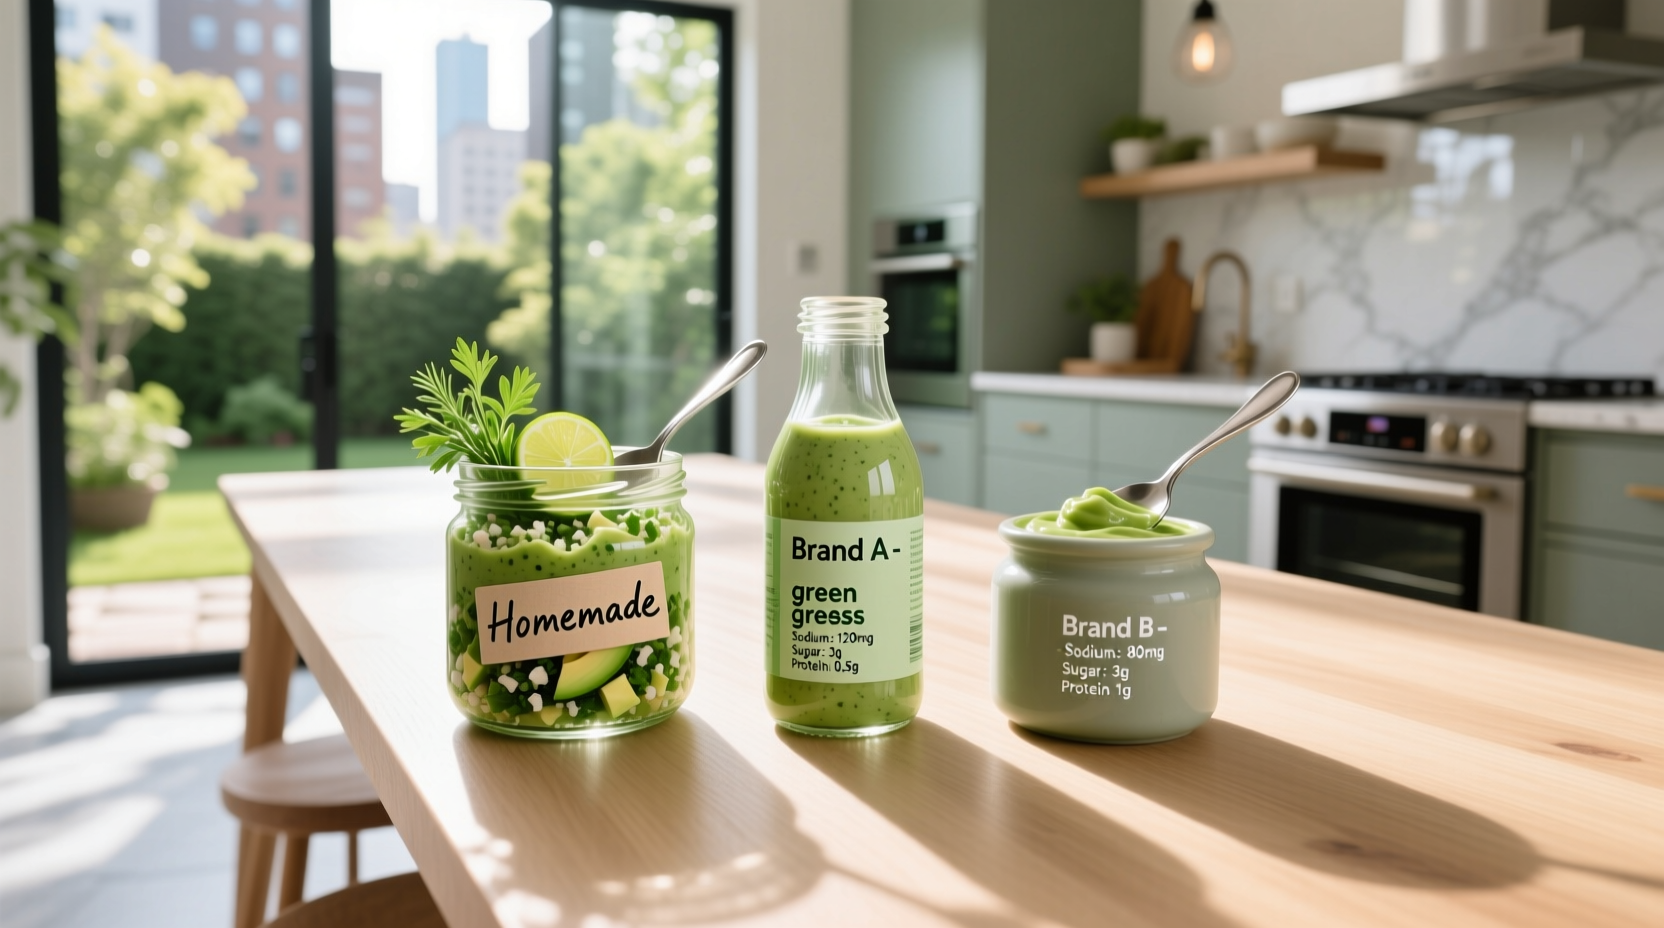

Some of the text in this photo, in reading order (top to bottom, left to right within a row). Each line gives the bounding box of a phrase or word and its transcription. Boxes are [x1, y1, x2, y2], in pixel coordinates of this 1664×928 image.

[791, 536, 864, 562] Brand
[791, 584, 857, 607] green
[487, 579, 661, 644] Homemade
[1062, 613, 1132, 639] Brand
[1064, 642, 1165, 662] Sodium: 80mg
[1062, 661, 1130, 682] Sugar: 3g
[1061, 679, 1132, 700] Protein 1g
